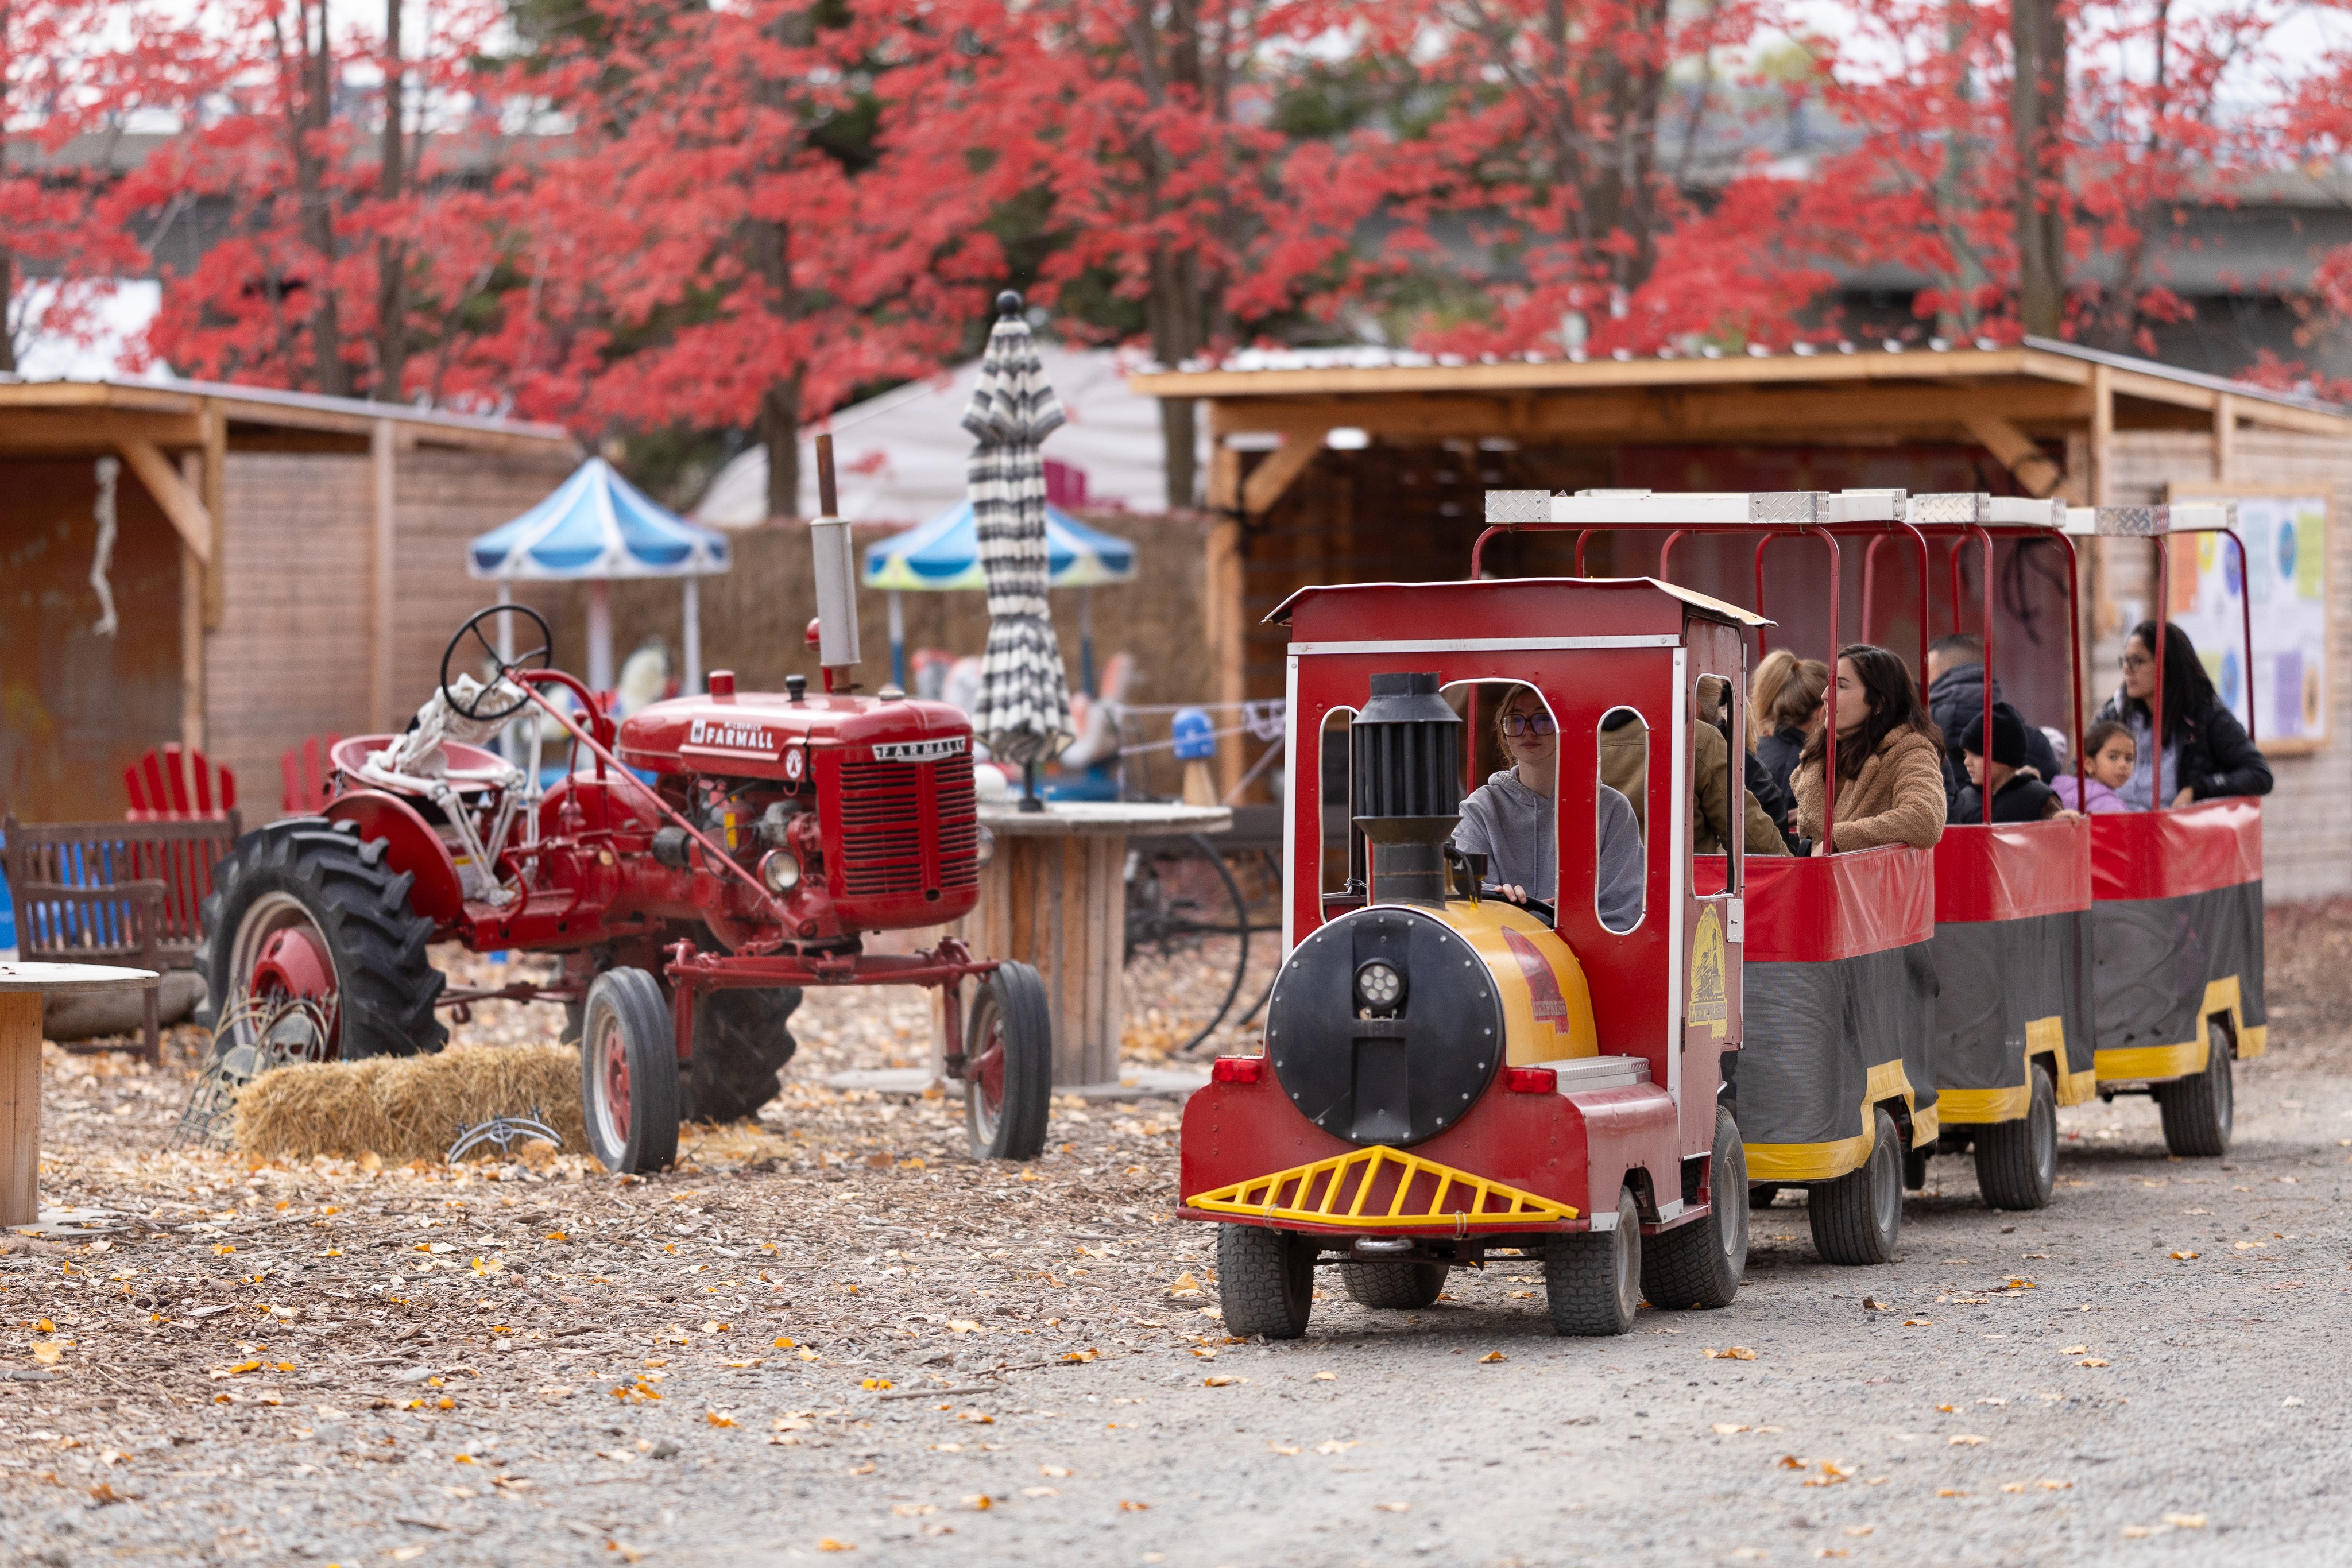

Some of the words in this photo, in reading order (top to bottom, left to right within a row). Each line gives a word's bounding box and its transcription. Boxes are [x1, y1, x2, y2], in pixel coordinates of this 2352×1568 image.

[706, 727, 774, 749] FARMALL
[883, 740, 961, 757] FARMALL
[1689, 1002, 1727, 1023] L'EXPRESS
